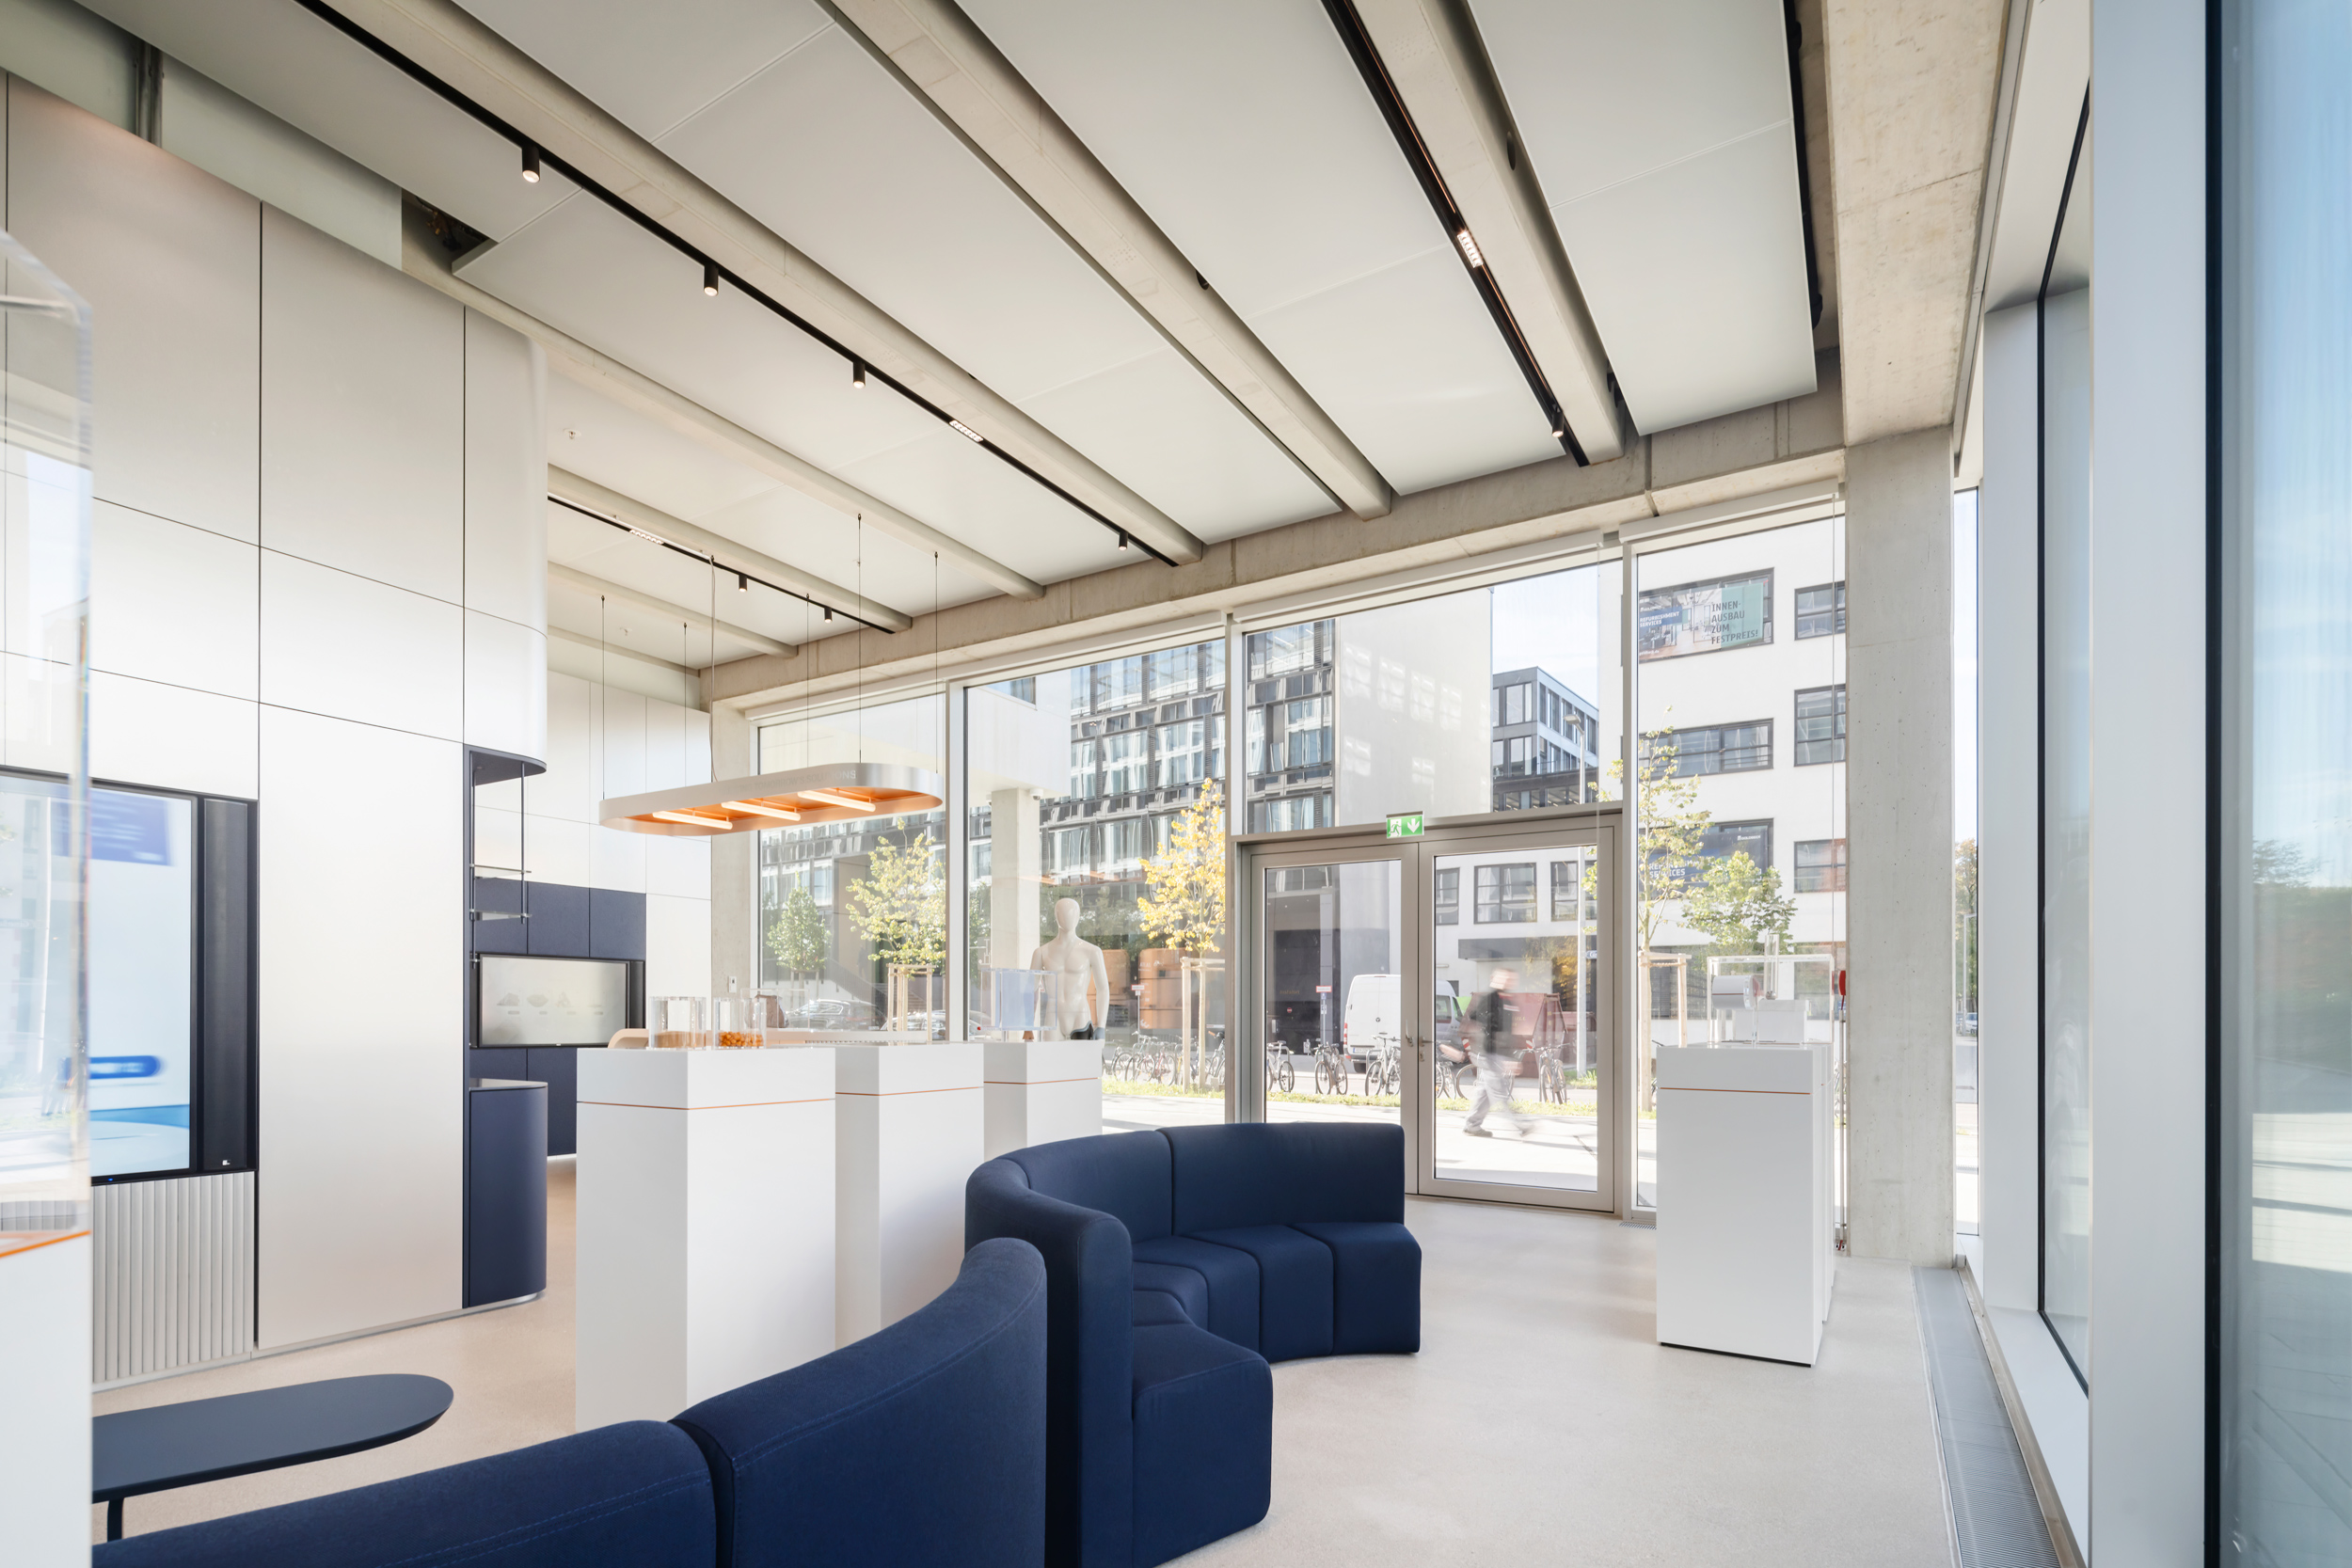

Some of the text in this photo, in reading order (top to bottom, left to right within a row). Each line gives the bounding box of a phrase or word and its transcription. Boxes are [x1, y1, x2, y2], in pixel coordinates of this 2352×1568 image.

[1712, 600, 1741, 611] INNEN-
[1640, 611, 1679, 622] REFURBISHMENT
[1711, 610, 1745, 623] AUSBAU
[1711, 624, 1730, 634] ZUM
[1711, 629, 1758, 644] FESTPREIS!
